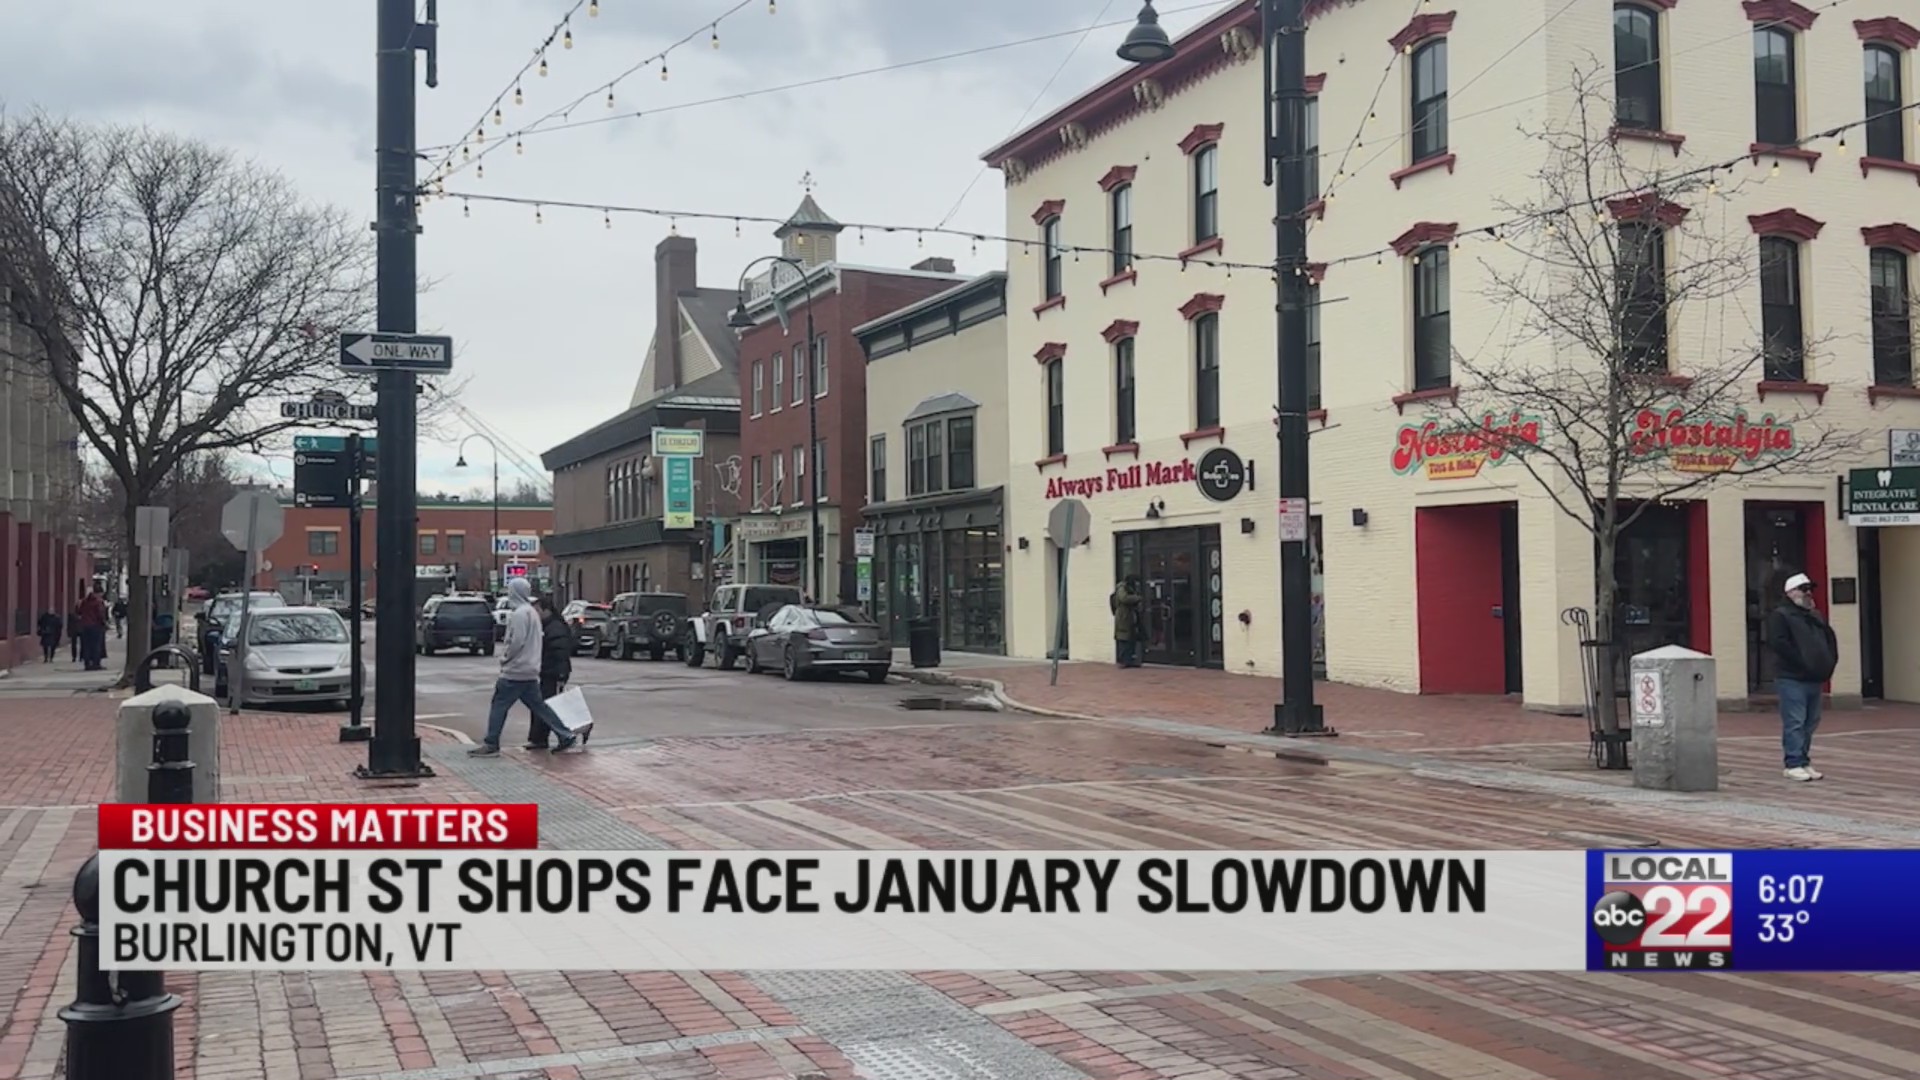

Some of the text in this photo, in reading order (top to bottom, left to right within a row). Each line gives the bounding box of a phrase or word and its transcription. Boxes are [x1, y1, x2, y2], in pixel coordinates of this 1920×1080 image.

[373, 344, 440, 359] ONE WAY
[282, 402, 359, 419] CHURCH
[1392, 411, 1540, 471] Nostalgia
[1632, 407, 1793, 460] Nostalgia
[1045, 458, 1197, 499] Always Full Mark
[1853, 489, 1917, 500] INTEGRATIVE
[1852, 501, 1919, 512] DENTAL CARE
[495, 540, 537, 552] Mobil
[1210, 550, 1221, 641] BOBA
